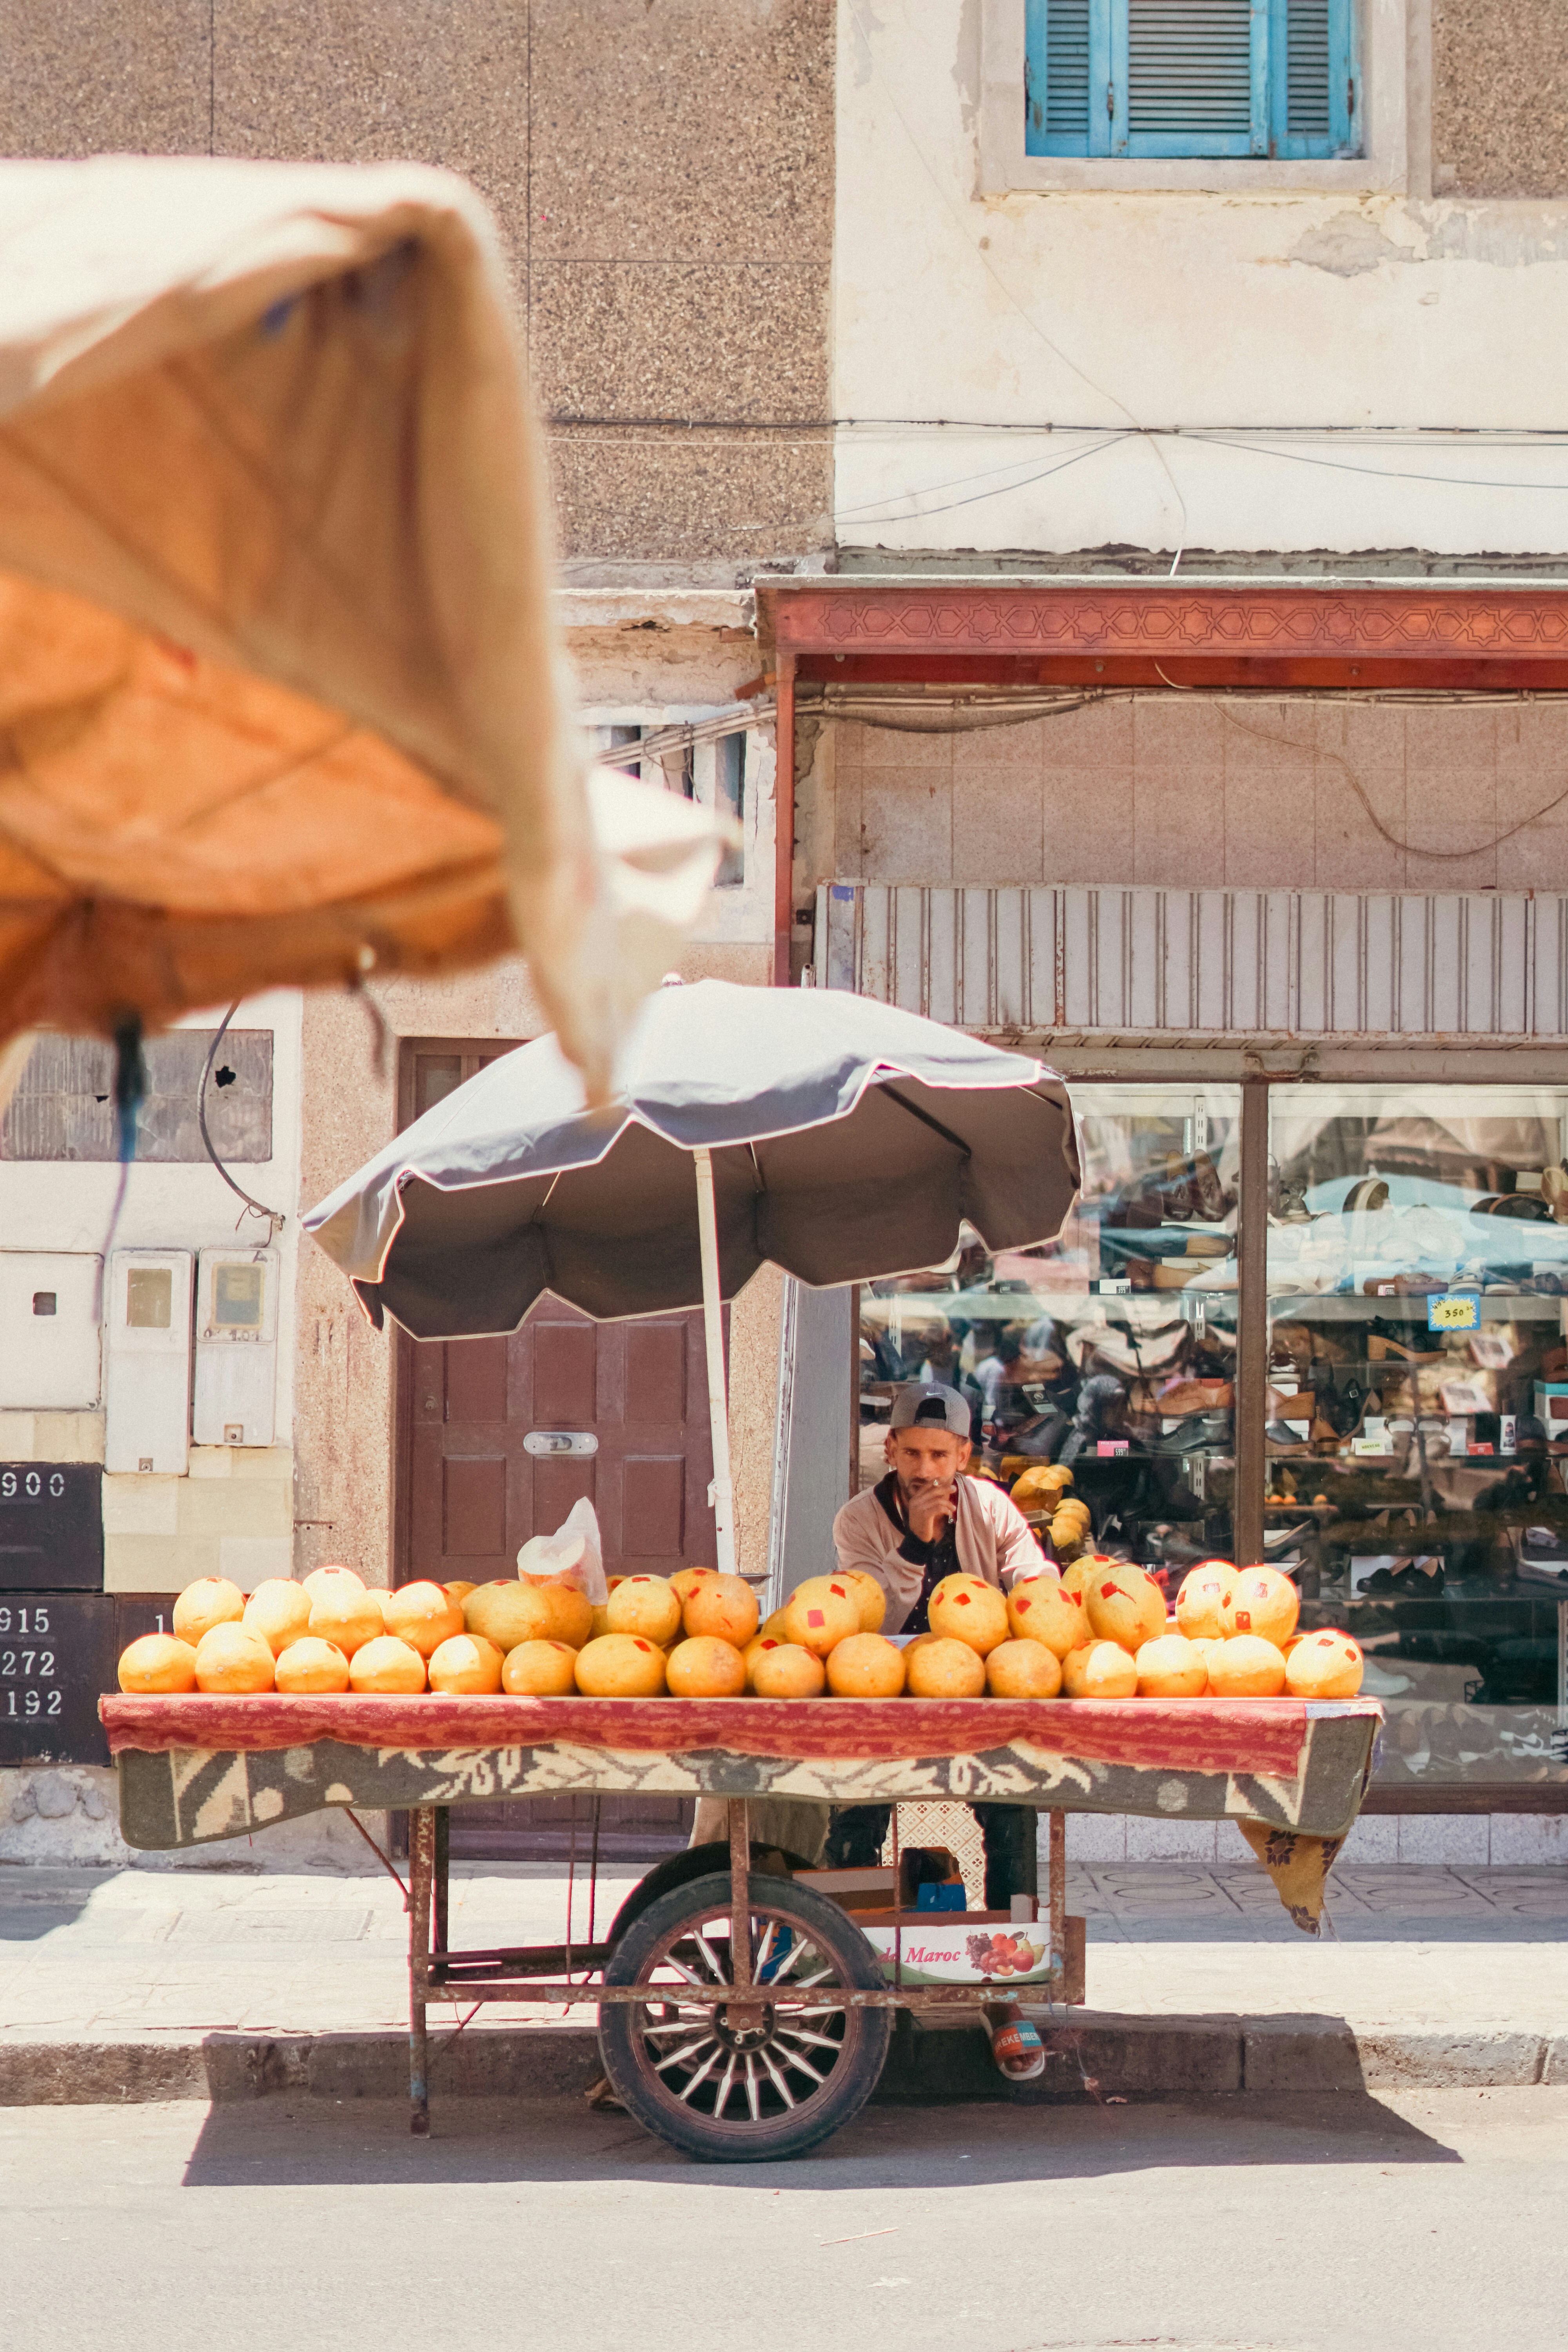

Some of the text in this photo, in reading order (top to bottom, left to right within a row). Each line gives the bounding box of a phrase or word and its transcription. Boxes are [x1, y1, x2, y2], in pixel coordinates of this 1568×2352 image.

[1445, 1309, 1463, 1318] 350
[2, 1472, 65, 1497] 900
[0, 1607, 49, 1633] 915
[2, 1651, 55, 1676] 272
[8, 1690, 62, 1715] 192
[904, 1947, 961, 1963] Maroc
